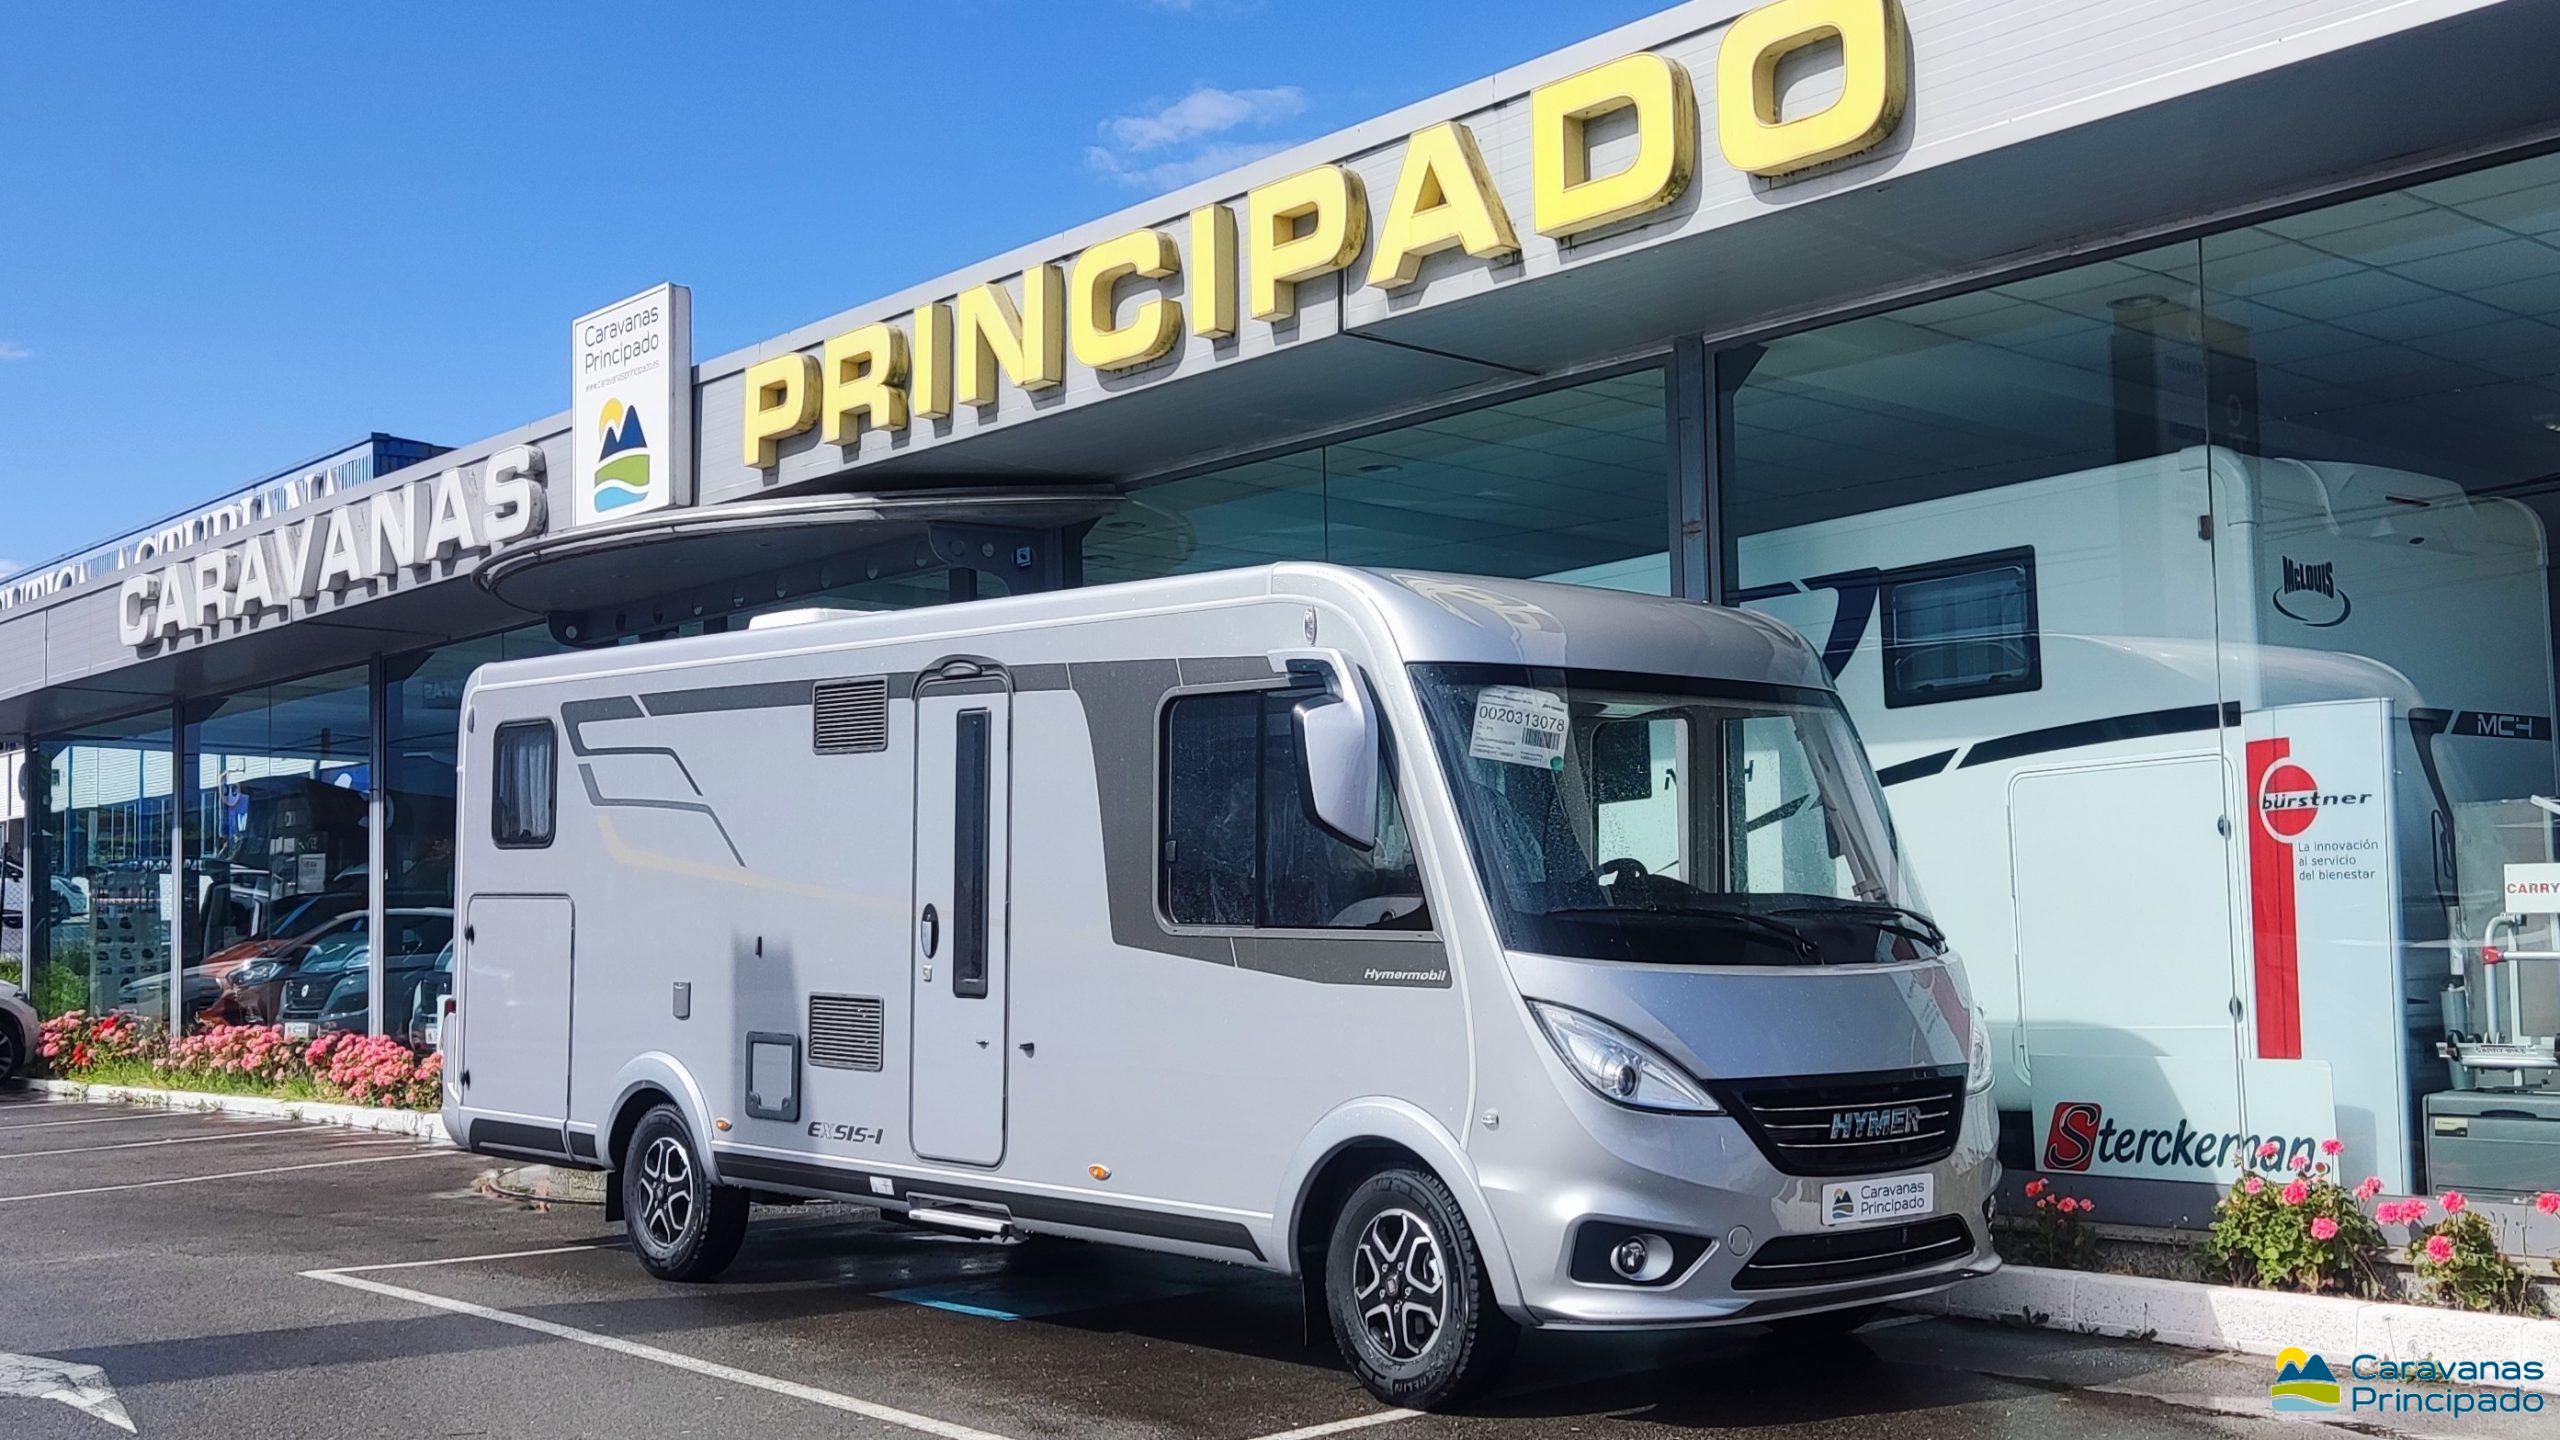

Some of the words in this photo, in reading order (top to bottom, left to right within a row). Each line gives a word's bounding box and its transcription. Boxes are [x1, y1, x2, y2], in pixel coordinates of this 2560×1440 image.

[743, 0, 1907, 470] PRINCIPADO
[584, 306, 659, 347] Caravanas
[584, 330, 660, 375] Principado
[119, 444, 547, 647] CARAVANAS
[1479, 705, 1565, 733] 0020313078
[2262, 791, 2373, 810] bürstner
[2298, 842, 2310, 853] La
[2314, 839, 2379, 852] innovación
[2298, 856, 2308, 867] al
[2311, 855, 2357, 867] servicio
[2299, 870, 2315, 881] del
[2319, 869, 2376, 881] bienestar
[1363, 967, 1447, 981] Hymermobil
[807, 1121, 884, 1145] EXSIS-I
[1829, 1105, 1921, 1139] HYMER
[2049, 1103, 2318, 1173] Sterckeman
[1860, 1182, 1925, 1200] Caravanas
[1860, 1195, 1925, 1216] Principado
